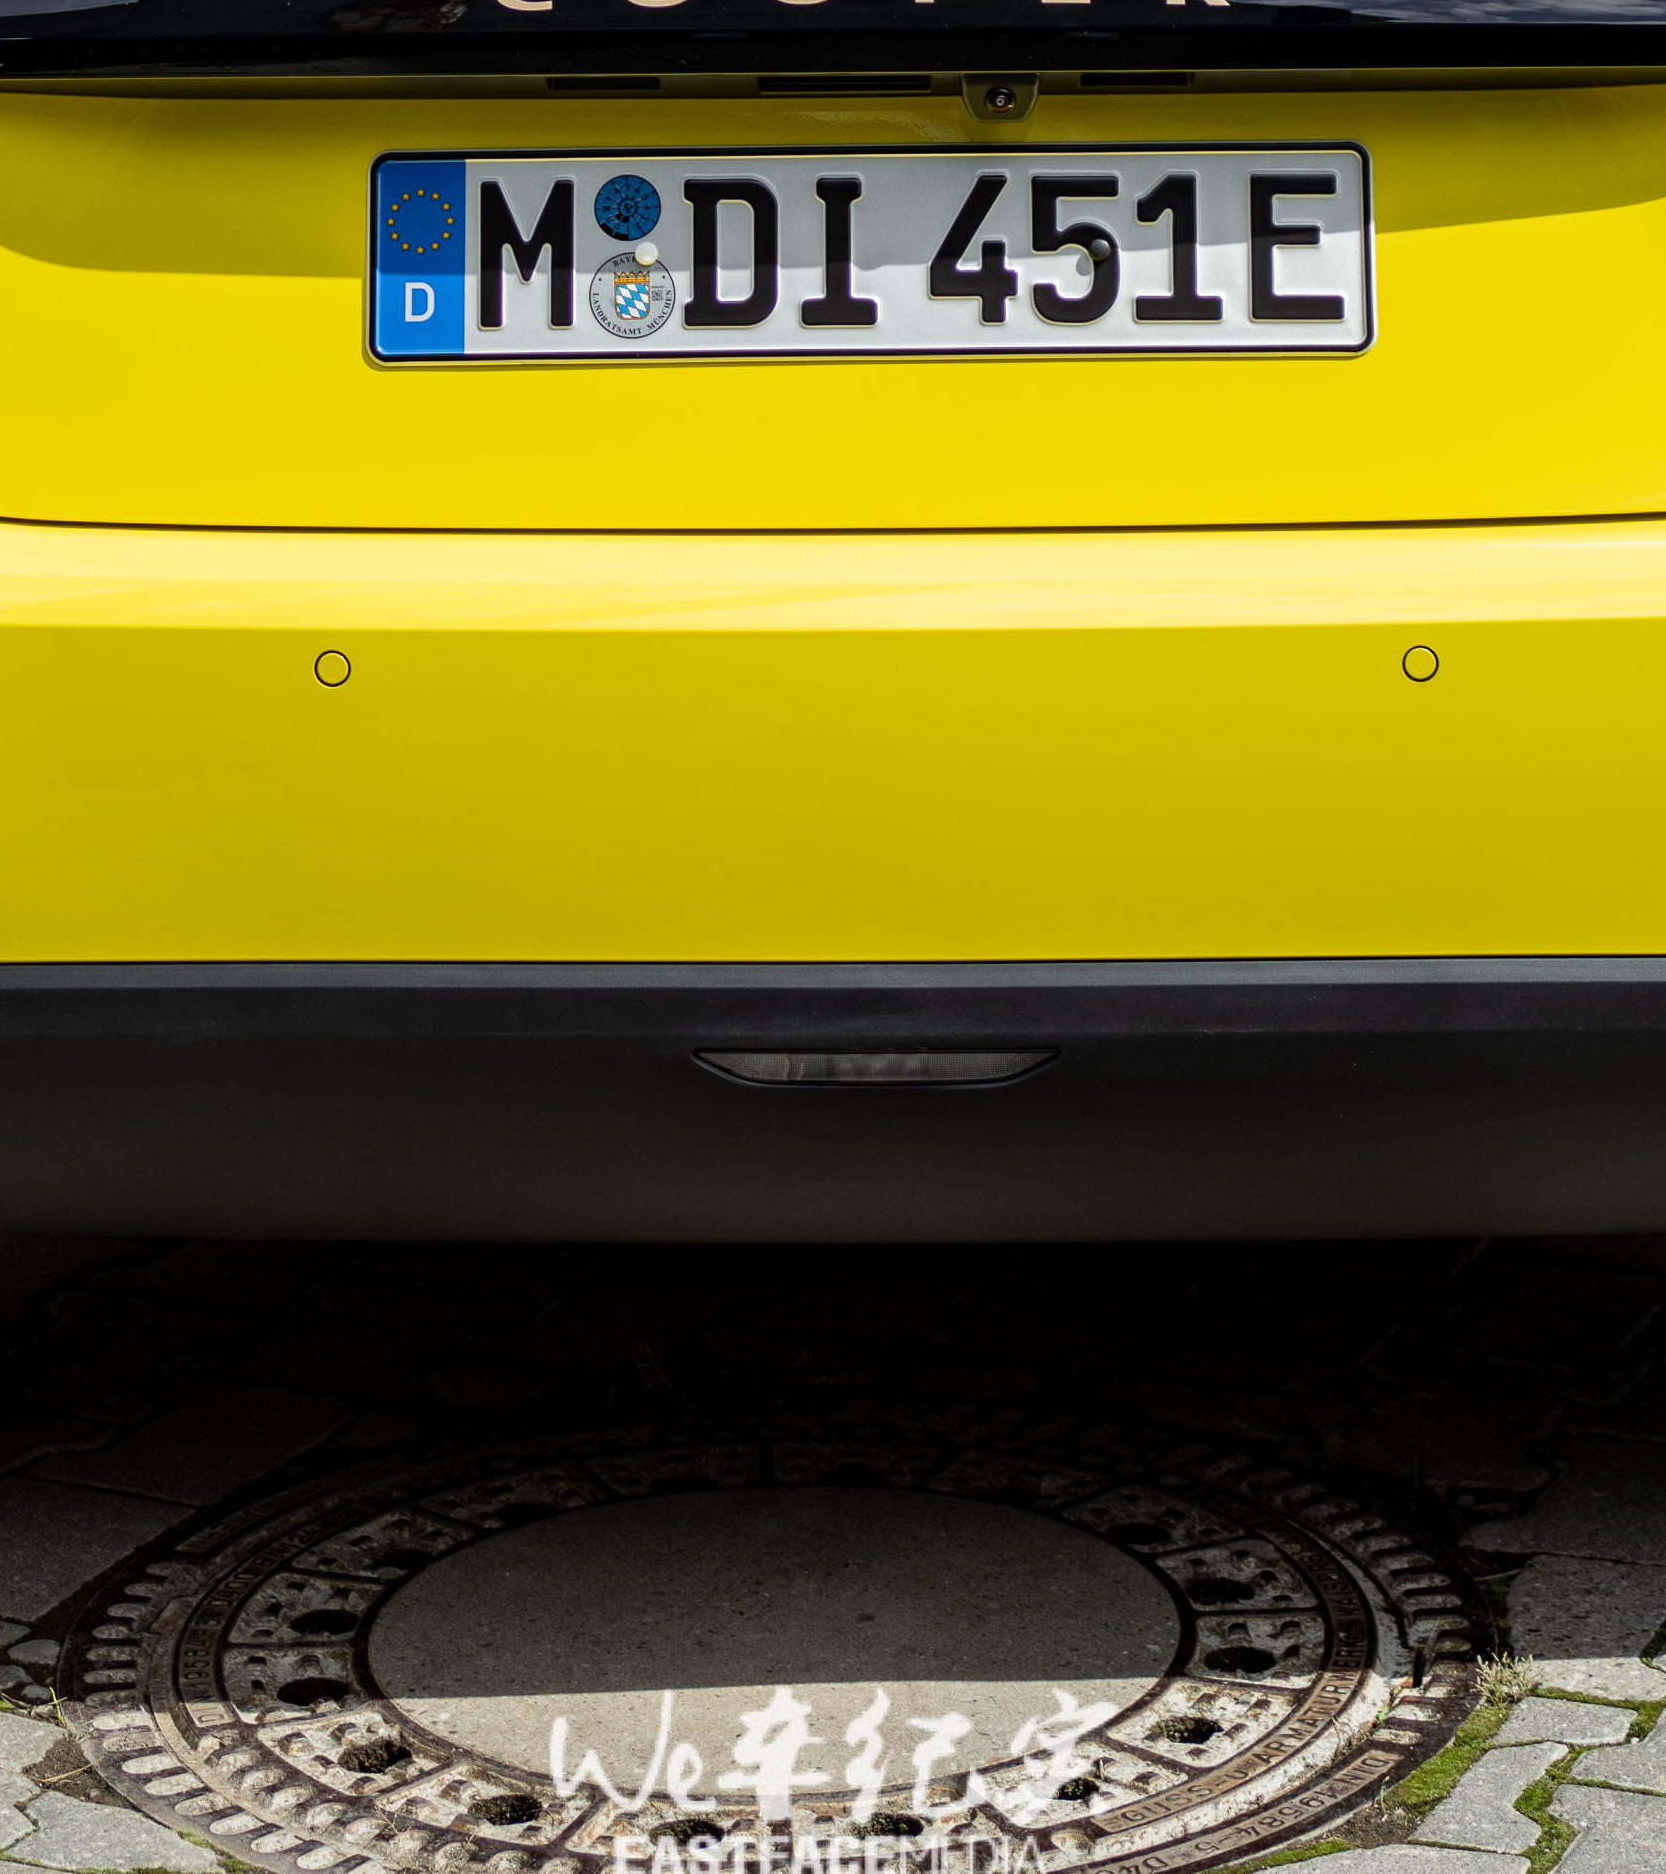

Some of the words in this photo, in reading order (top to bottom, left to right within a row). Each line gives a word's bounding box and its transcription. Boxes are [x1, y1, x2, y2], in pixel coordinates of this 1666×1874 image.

[478, 179, 575, 330] M
[682, 176, 879, 329] DI
[928, 171, 1346, 327] 451E
[404, 281, 436, 323] D
[593, 292, 643, 335] LANDRATSAMT
